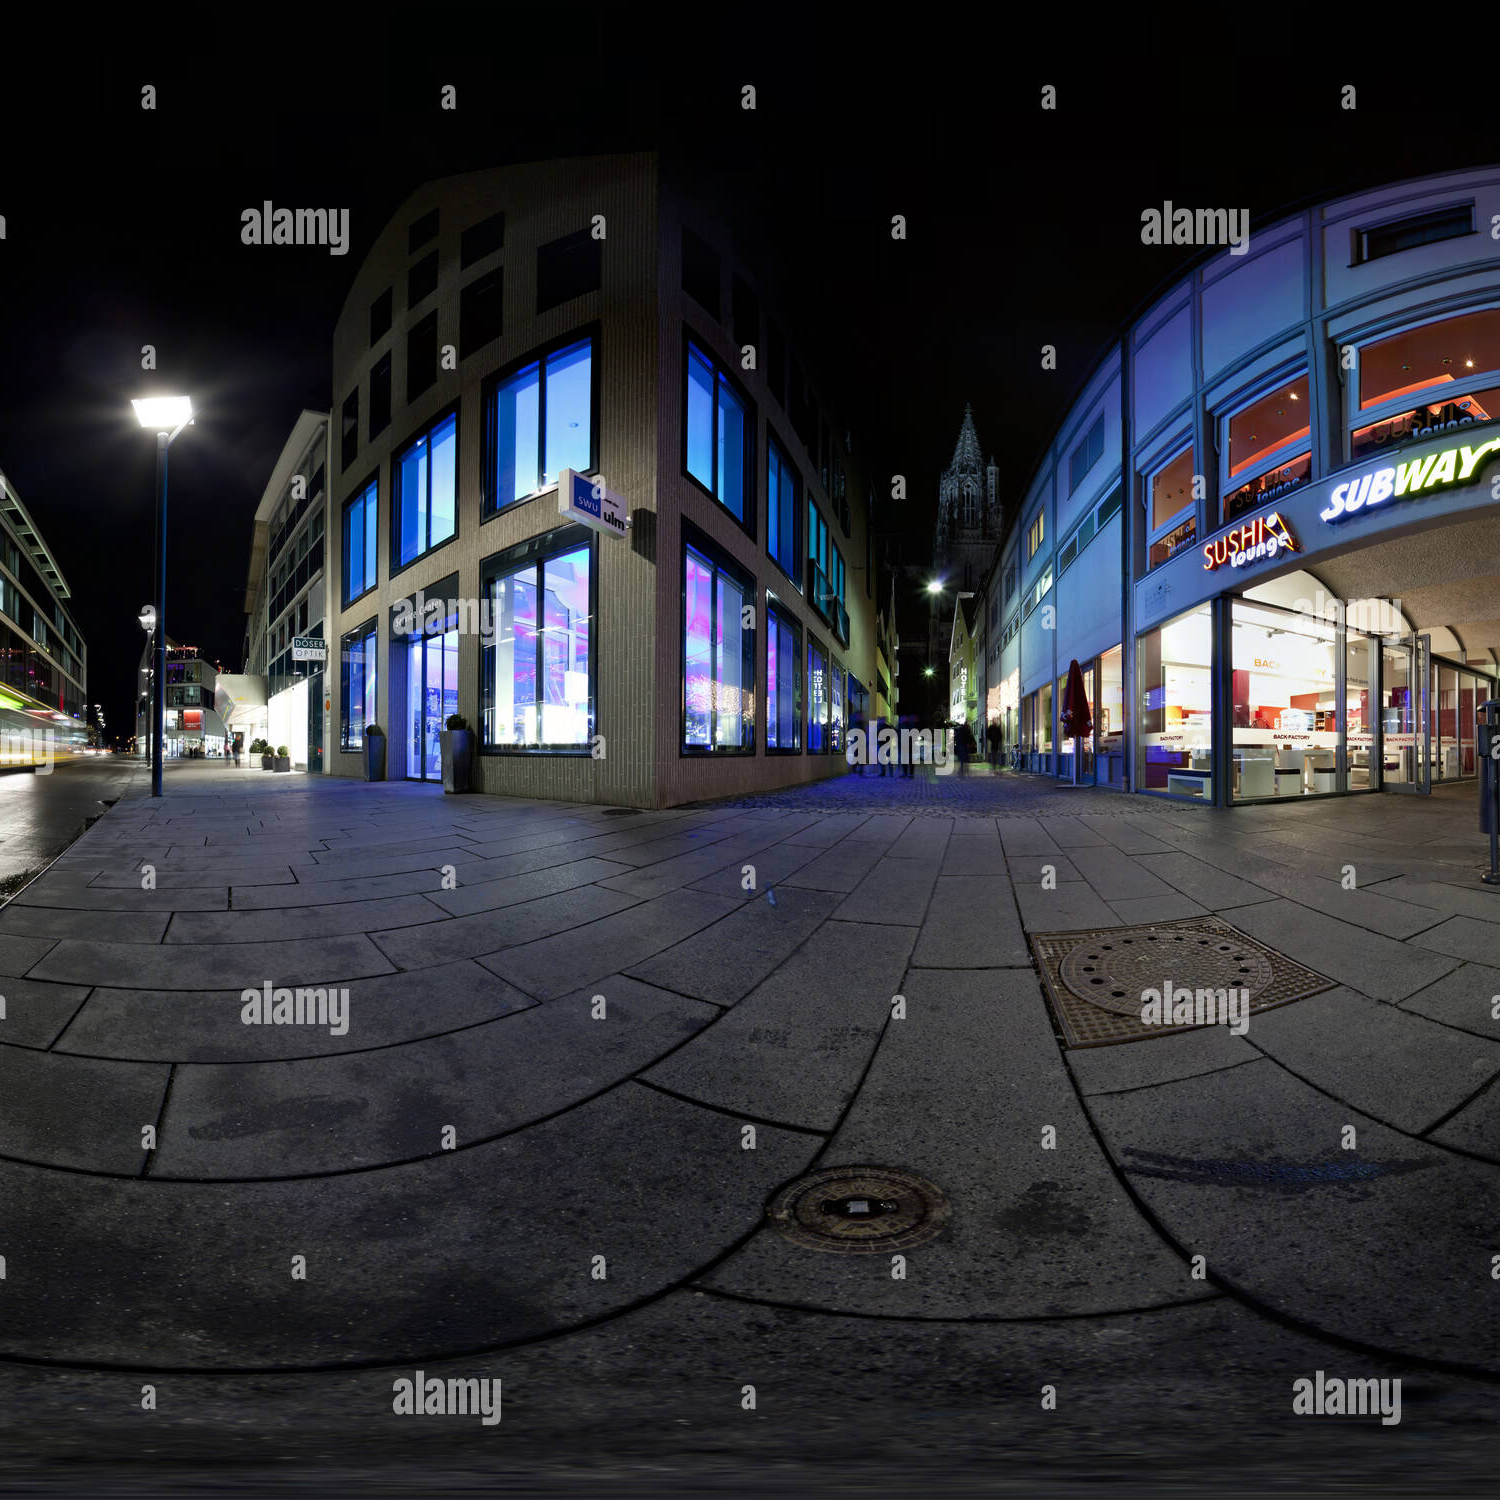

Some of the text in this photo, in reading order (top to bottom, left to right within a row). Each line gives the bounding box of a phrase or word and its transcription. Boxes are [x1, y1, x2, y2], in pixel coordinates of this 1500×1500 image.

[1320, 436, 1500, 523] SUBWAY
[603, 511, 625, 531] ulm
[1203, 517, 1264, 571] SUSHI
[1230, 532, 1289, 568] lounge
[960, 667, 968, 703] HOTEL
